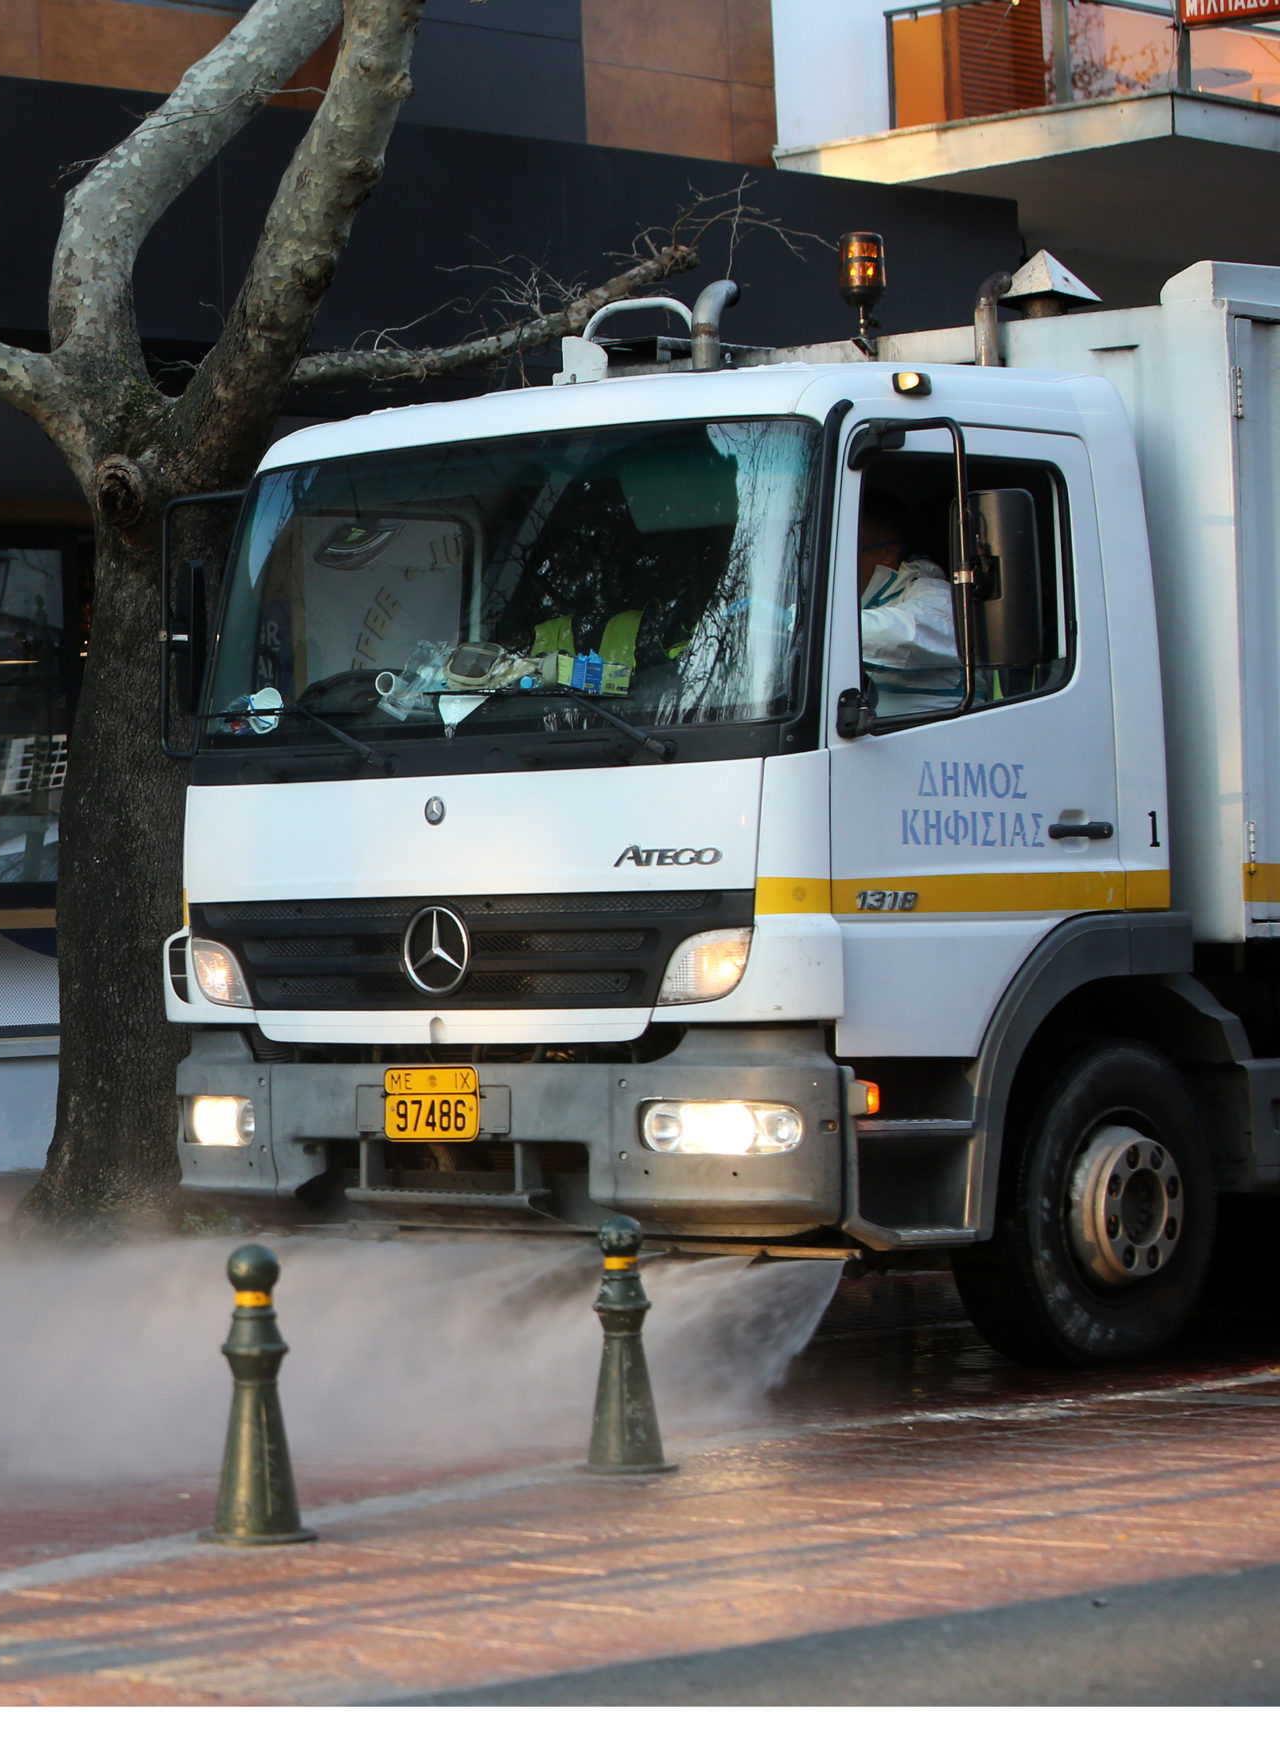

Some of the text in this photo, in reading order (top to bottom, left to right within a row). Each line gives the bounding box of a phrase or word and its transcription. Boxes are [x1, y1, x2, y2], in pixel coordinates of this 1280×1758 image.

[918, 760, 1028, 800] ΔΗΜΟΣ
[901, 809, 1046, 849] ΚΗΦΙΣΙΑΣ
[613, 845, 722, 867] ATEGO
[855, 890, 919, 911] 1318
[396, 1099, 467, 1132] 97486
